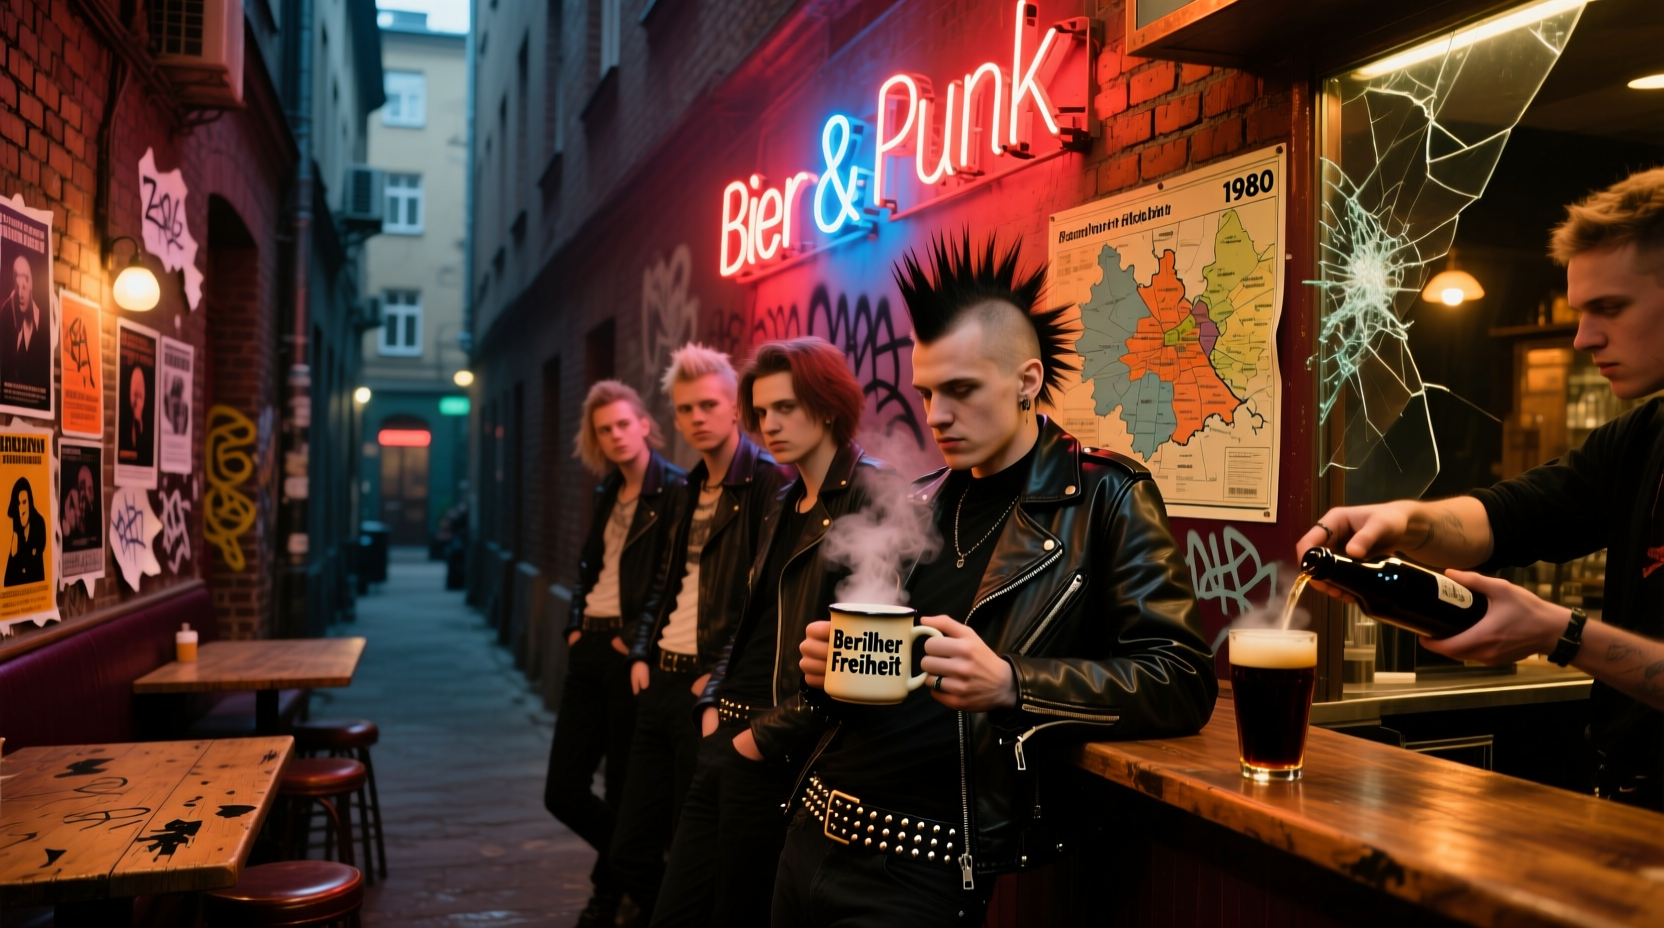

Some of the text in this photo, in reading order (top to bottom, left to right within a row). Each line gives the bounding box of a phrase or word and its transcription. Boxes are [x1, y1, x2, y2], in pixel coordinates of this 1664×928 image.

[720, 0, 1059, 277] Bier & Punk
[1222, 169, 1274, 203] 1980
[831, 651, 902, 677] Freiheit
